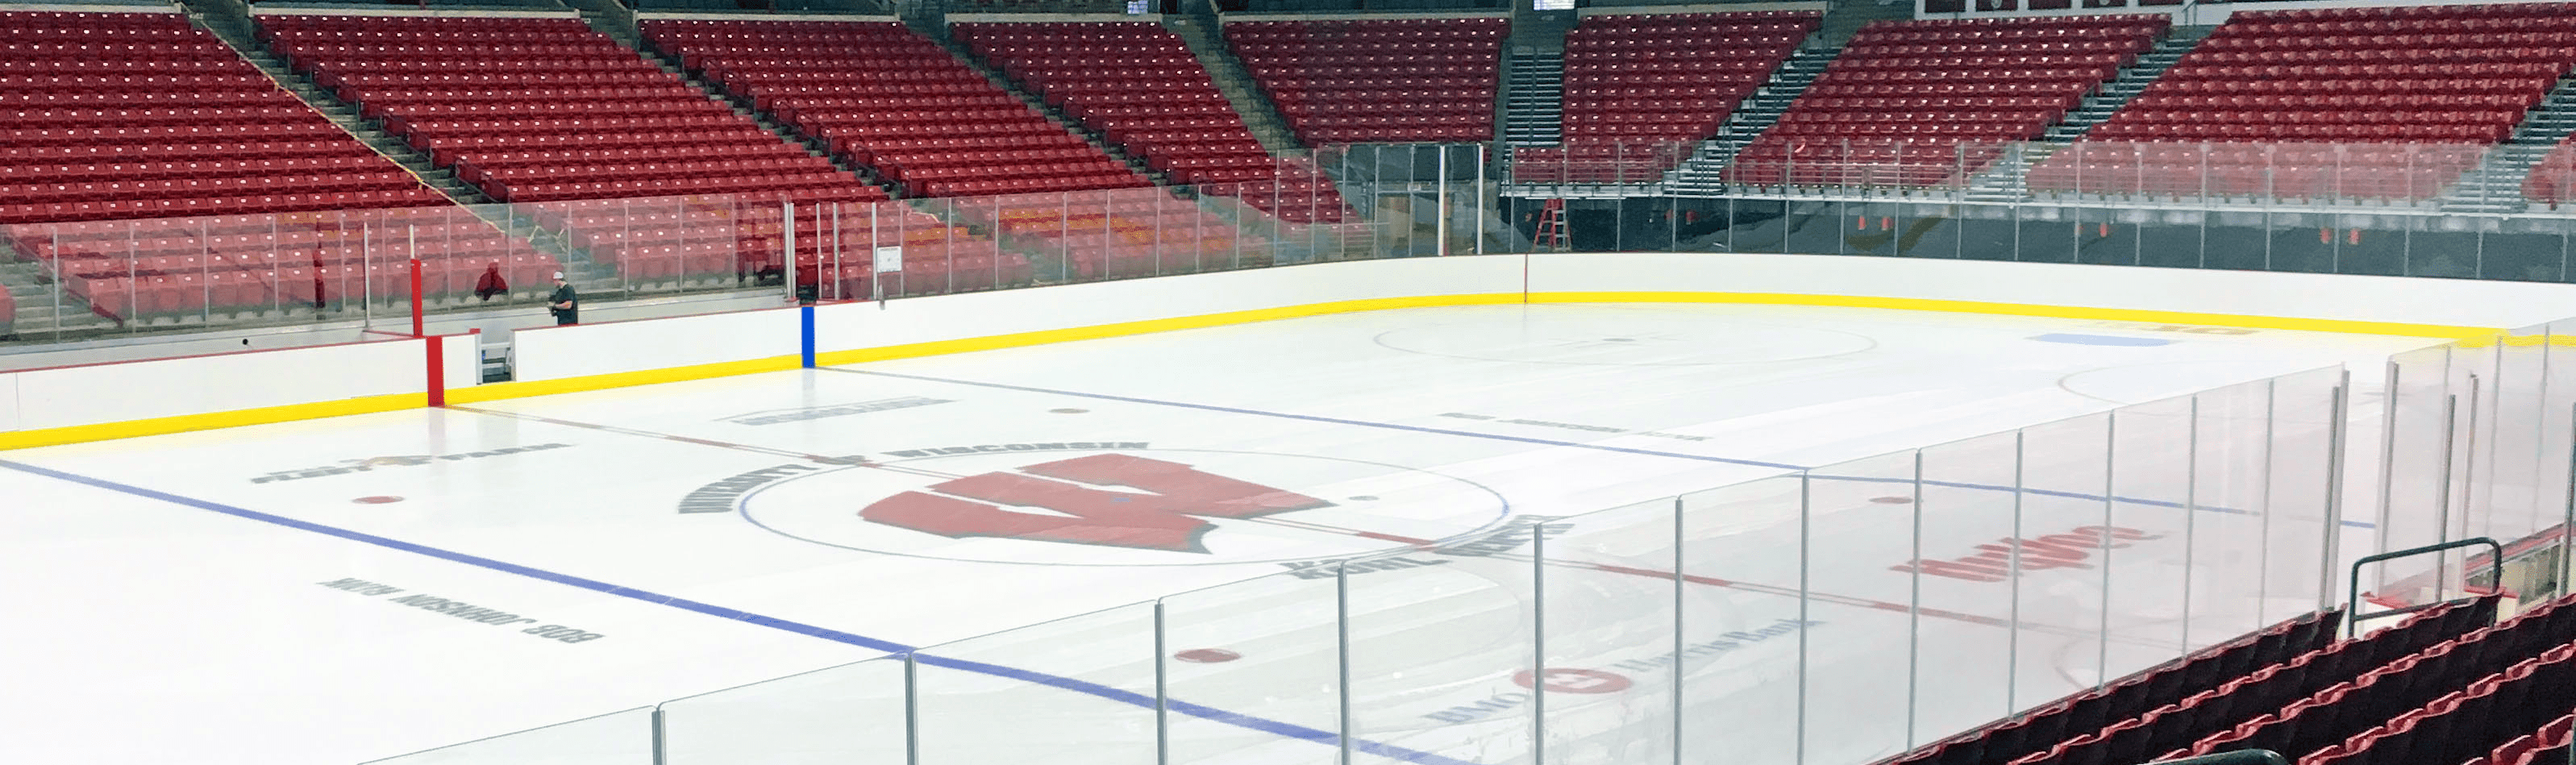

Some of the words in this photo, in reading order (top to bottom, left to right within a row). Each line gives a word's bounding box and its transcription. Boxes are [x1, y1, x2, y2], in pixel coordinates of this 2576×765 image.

[879, 442, 1150, 458] WISCONSIN
[857, 453, 1338, 555] W
[388, 594, 538, 625] JOHNSON
[521, 625, 606, 643] BOB
[1422, 692, 1529, 723] BMO
